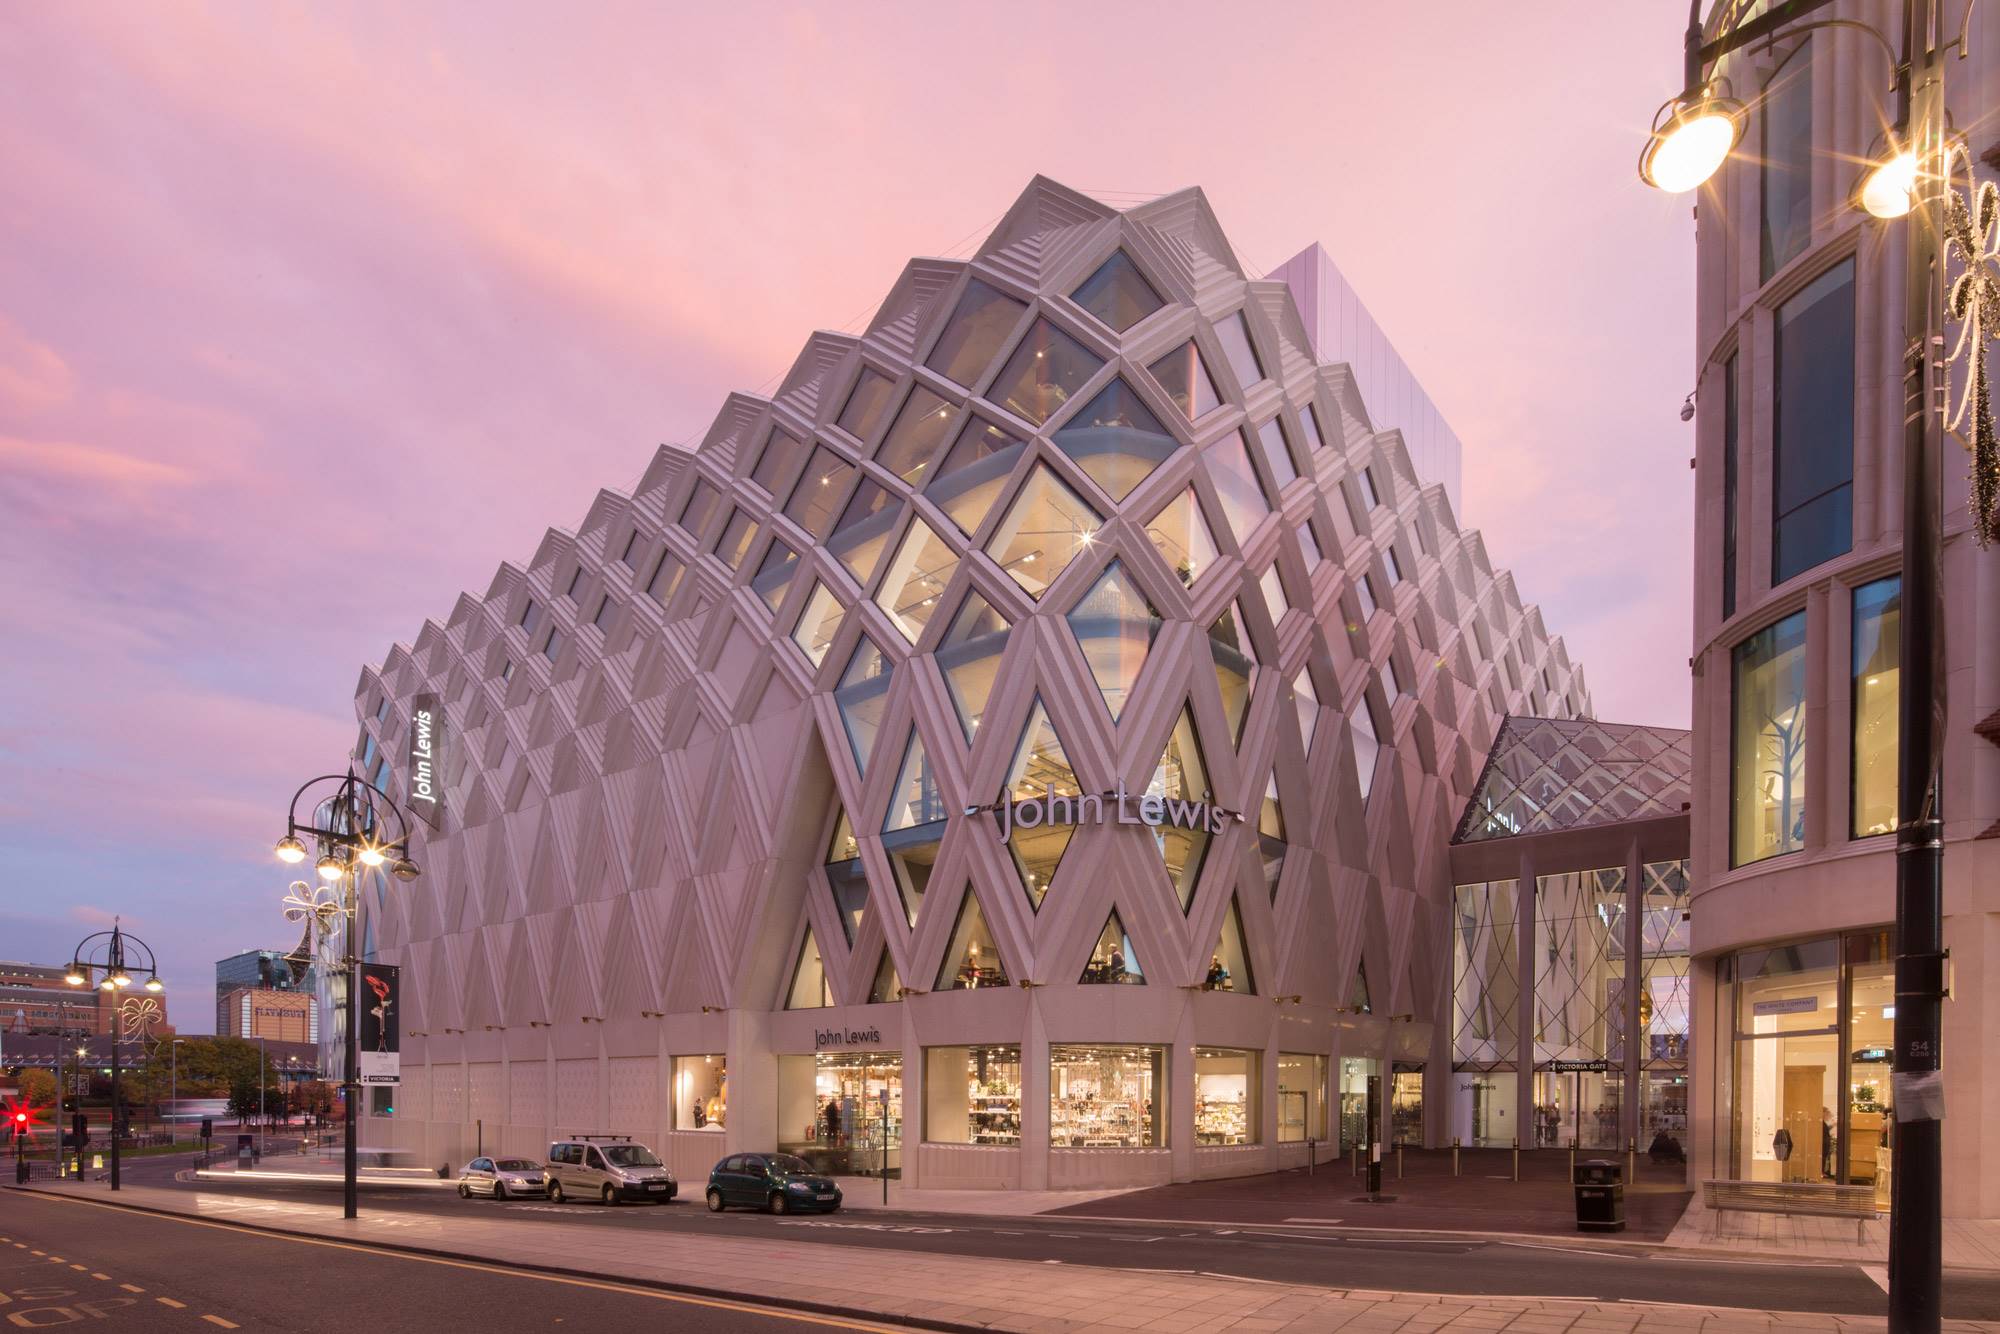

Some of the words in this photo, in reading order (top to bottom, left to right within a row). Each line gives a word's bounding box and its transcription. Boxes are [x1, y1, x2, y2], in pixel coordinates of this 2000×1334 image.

[412, 711, 431, 759] Lewis
[412, 762, 436, 803] John
[1000, 783, 1103, 845] John
[1117, 777, 1225, 835] Lewis
[815, 1028, 842, 1050] John
[844, 1025, 880, 1044] Lewis
[1911, 1041, 1929, 1051] 54
